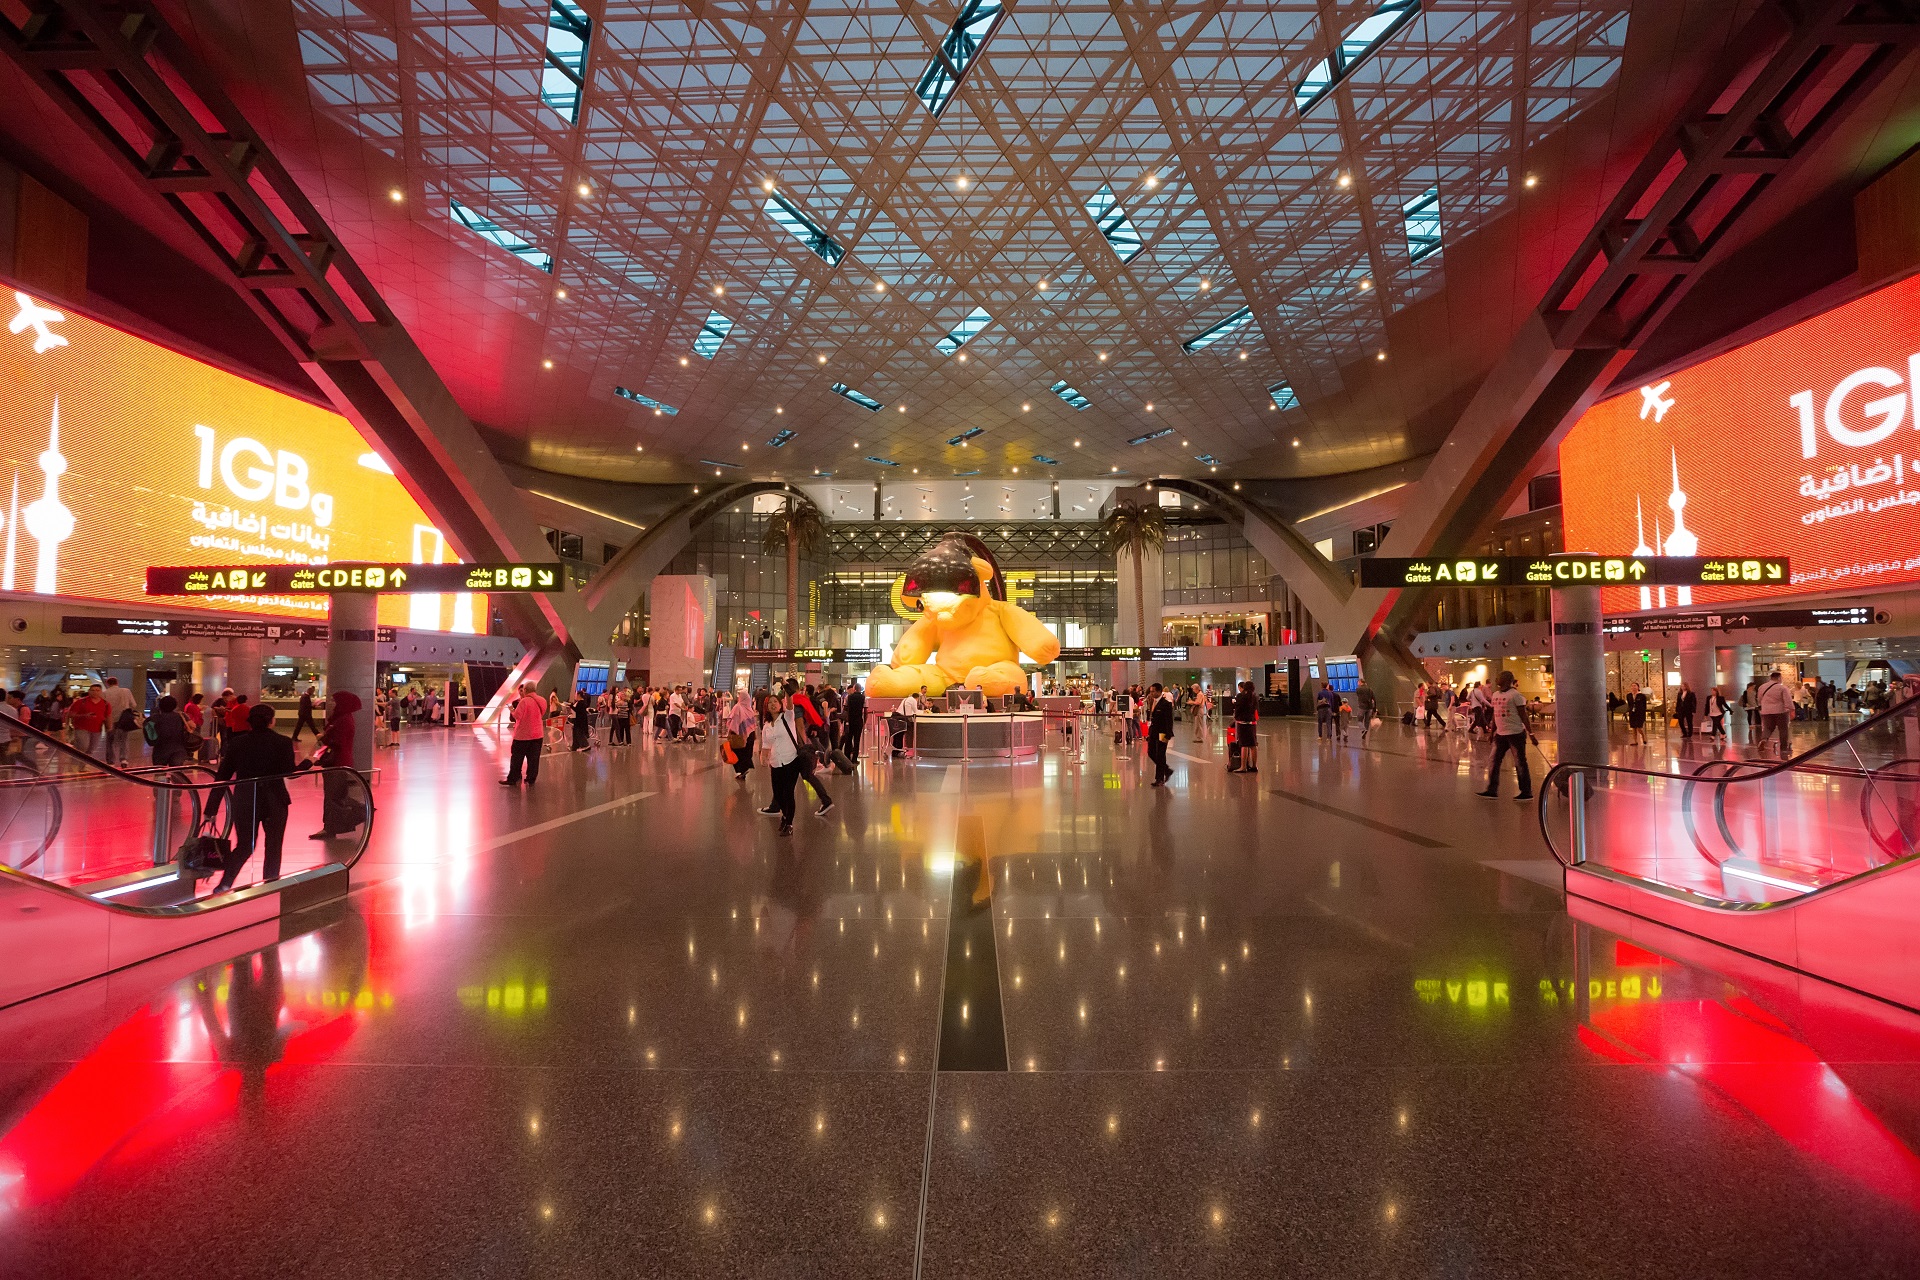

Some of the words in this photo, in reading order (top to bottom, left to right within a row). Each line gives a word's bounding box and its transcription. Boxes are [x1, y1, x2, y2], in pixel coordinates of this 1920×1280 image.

[1789, 352, 1920, 459] 1G
[194, 423, 310, 510] 1GB
[1799, 454, 1905, 500] إضافية
[1867, 489, 1920, 513] جلس
[191, 501, 267, 540] إضافية
[1801, 498, 1864, 525] التعاون
[189, 535, 240, 551] التعاون
[270, 522, 330, 552] بيانات
[240, 543, 284, 559] مجلس
[294, 569, 315, 579] بوابات
[470, 568, 492, 578] بوابات
[1405, 573, 1431, 583] Gates
[1435, 563, 1452, 580] A
[1408, 562, 1431, 572] بوابات
[1529, 561, 1552, 571] بوابات
[1701, 571, 1725, 580] Gates
[1727, 562, 1740, 579] B
[1703, 561, 1725, 571] بوابات
[185, 582, 209, 590] Gates
[211, 572, 227, 588] A
[189, 572, 209, 581] بوابات
[290, 580, 315, 589] Gates
[466, 579, 492, 588] Gates
[495, 569, 508, 586] B
[1526, 571, 1552, 581] Gates
